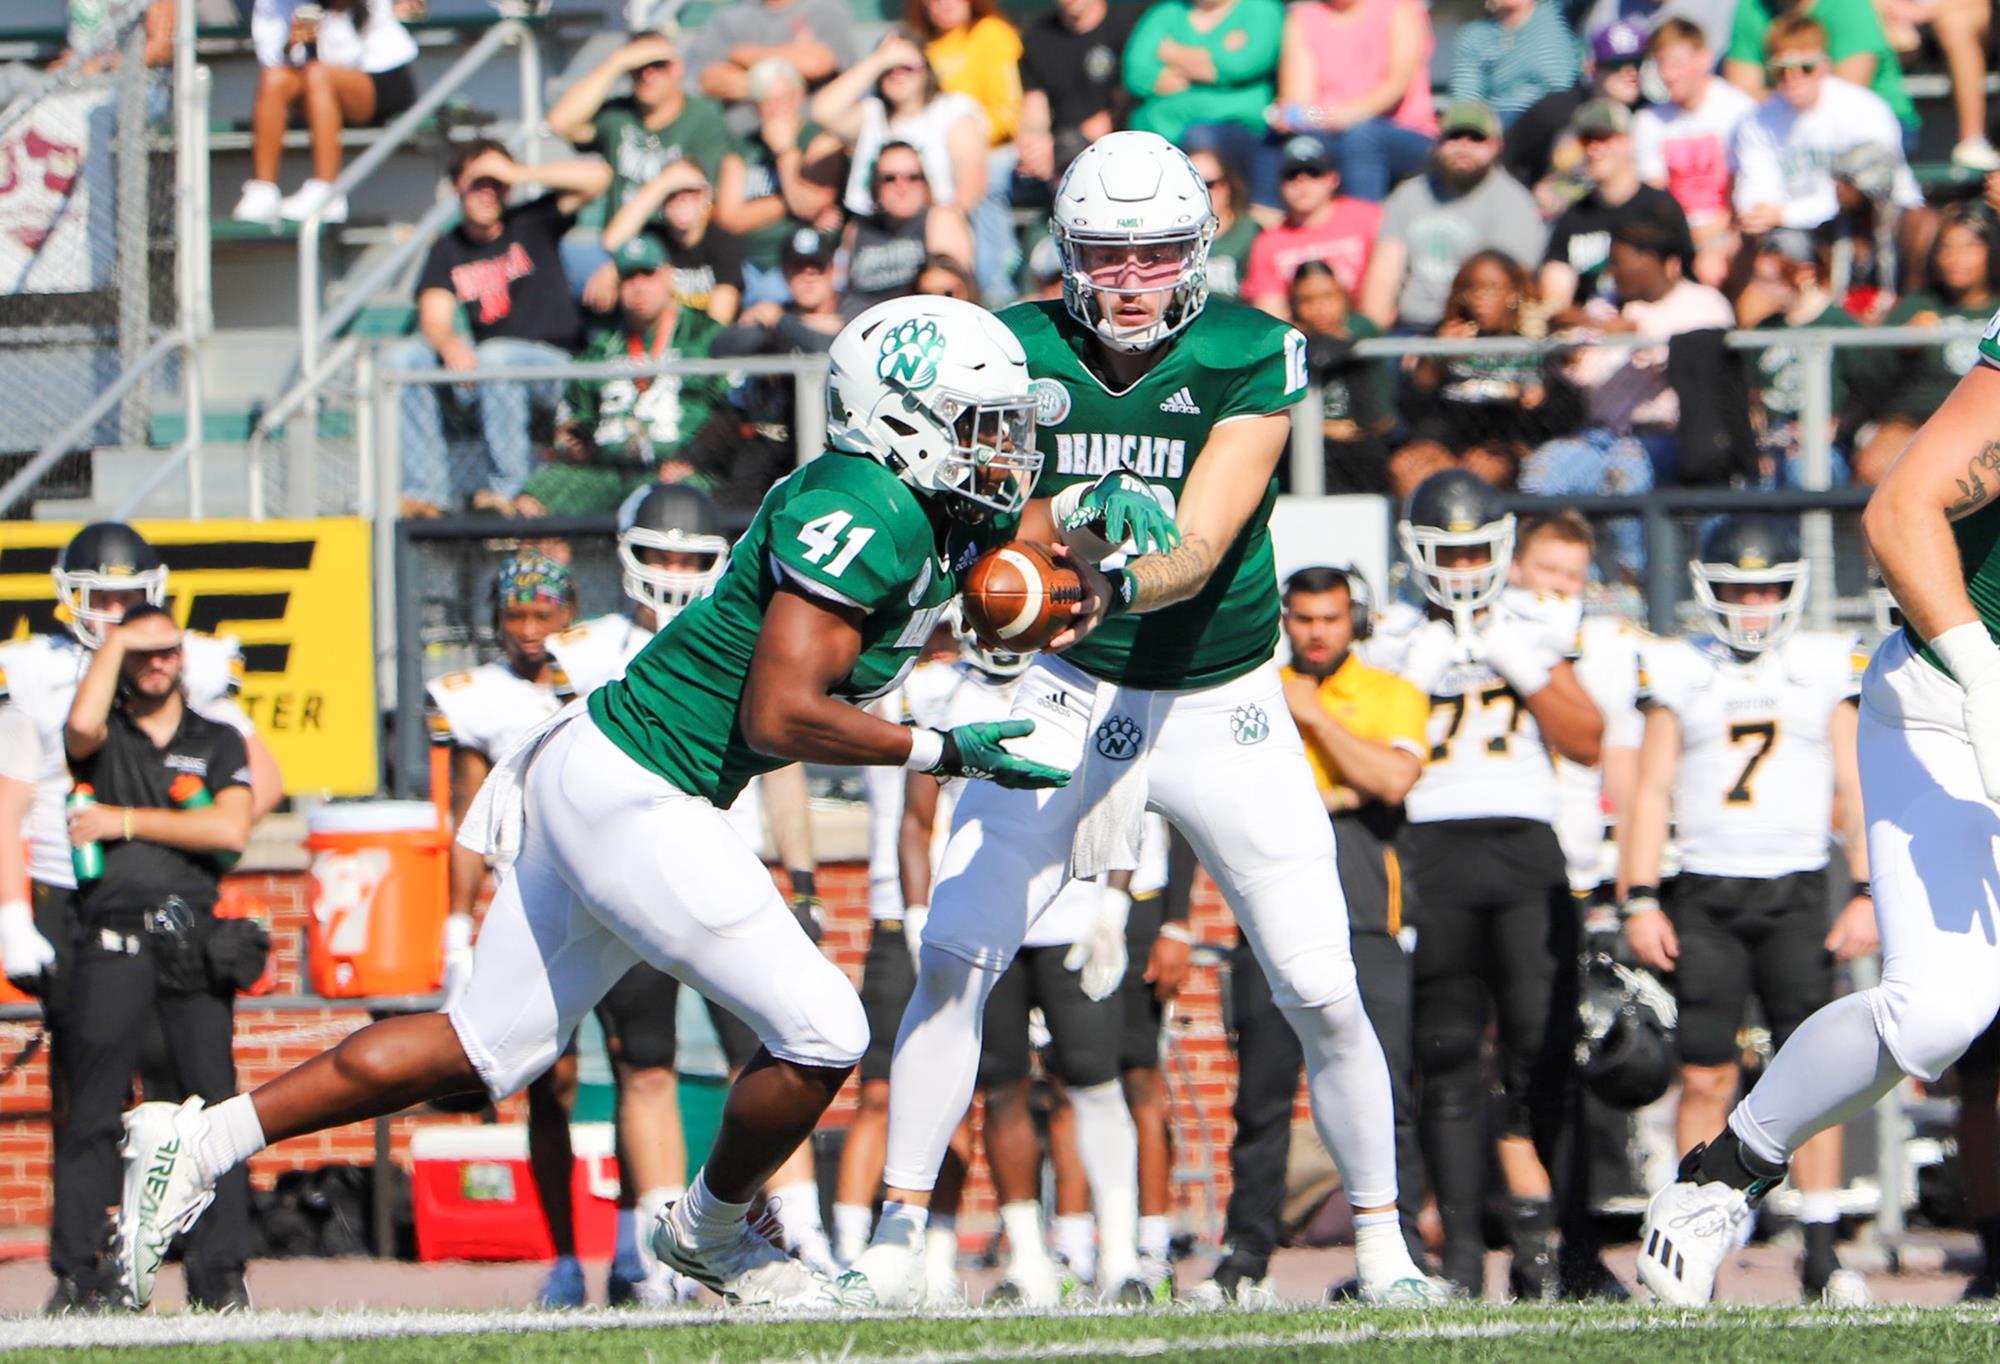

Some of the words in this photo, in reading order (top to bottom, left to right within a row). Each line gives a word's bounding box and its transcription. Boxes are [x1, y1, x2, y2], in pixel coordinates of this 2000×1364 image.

[889, 352, 922, 382] N
[1159, 402, 1201, 415] adidas
[1055, 433, 1186, 479] BEARCATS
[796, 509, 876, 579] 41
[1242, 724, 1259, 742] N
[1429, 682, 1527, 762] 77
[1103, 737, 1127, 755] N
[1726, 719, 1778, 803] 7
